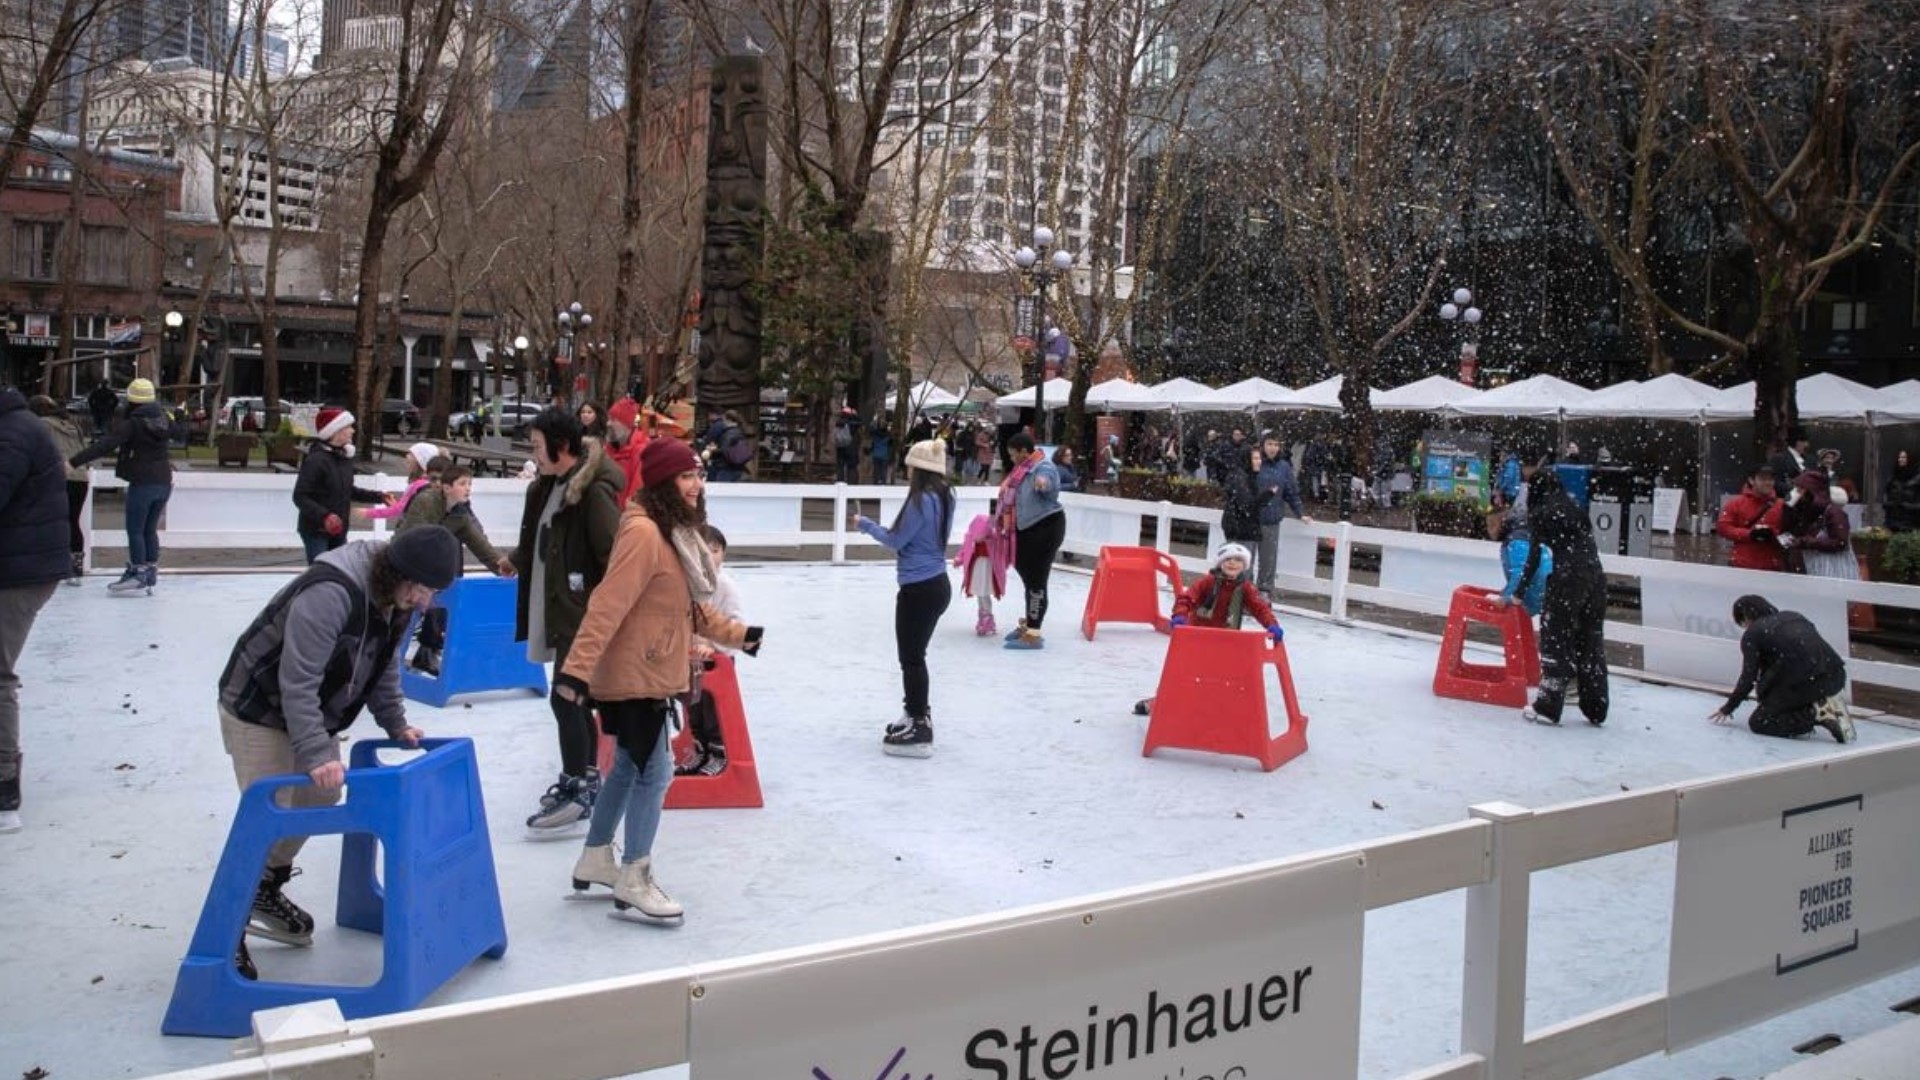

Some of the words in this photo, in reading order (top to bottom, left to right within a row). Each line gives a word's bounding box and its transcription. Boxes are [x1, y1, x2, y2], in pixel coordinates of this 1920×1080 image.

[1808, 828, 1853, 855] ALLIANCE
[1835, 851, 1852, 871] FOR
[1799, 876, 1852, 910] PIONEER
[1802, 900, 1852, 933] SQUARE
[964, 966, 1312, 1080] Steinhauer
